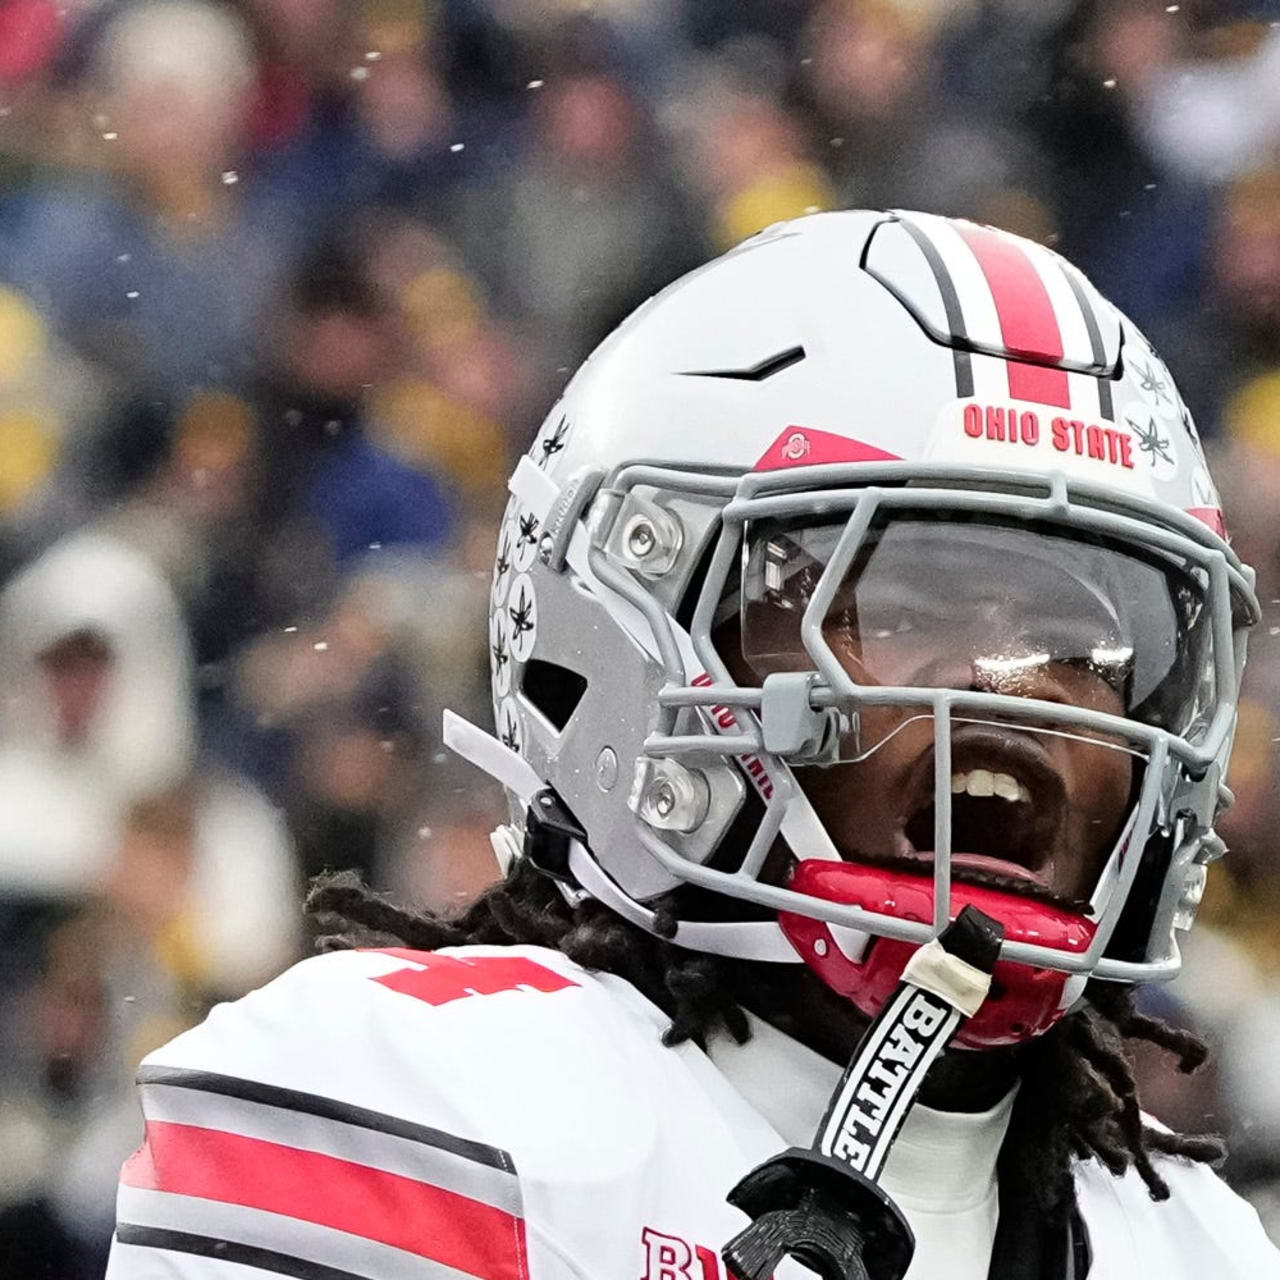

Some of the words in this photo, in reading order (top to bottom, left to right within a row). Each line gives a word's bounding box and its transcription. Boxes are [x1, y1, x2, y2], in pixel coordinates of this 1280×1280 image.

[964, 403, 1039, 446] OHIO
[1052, 417, 1134, 469] STATE
[833, 994, 947, 1171] BATTLE
